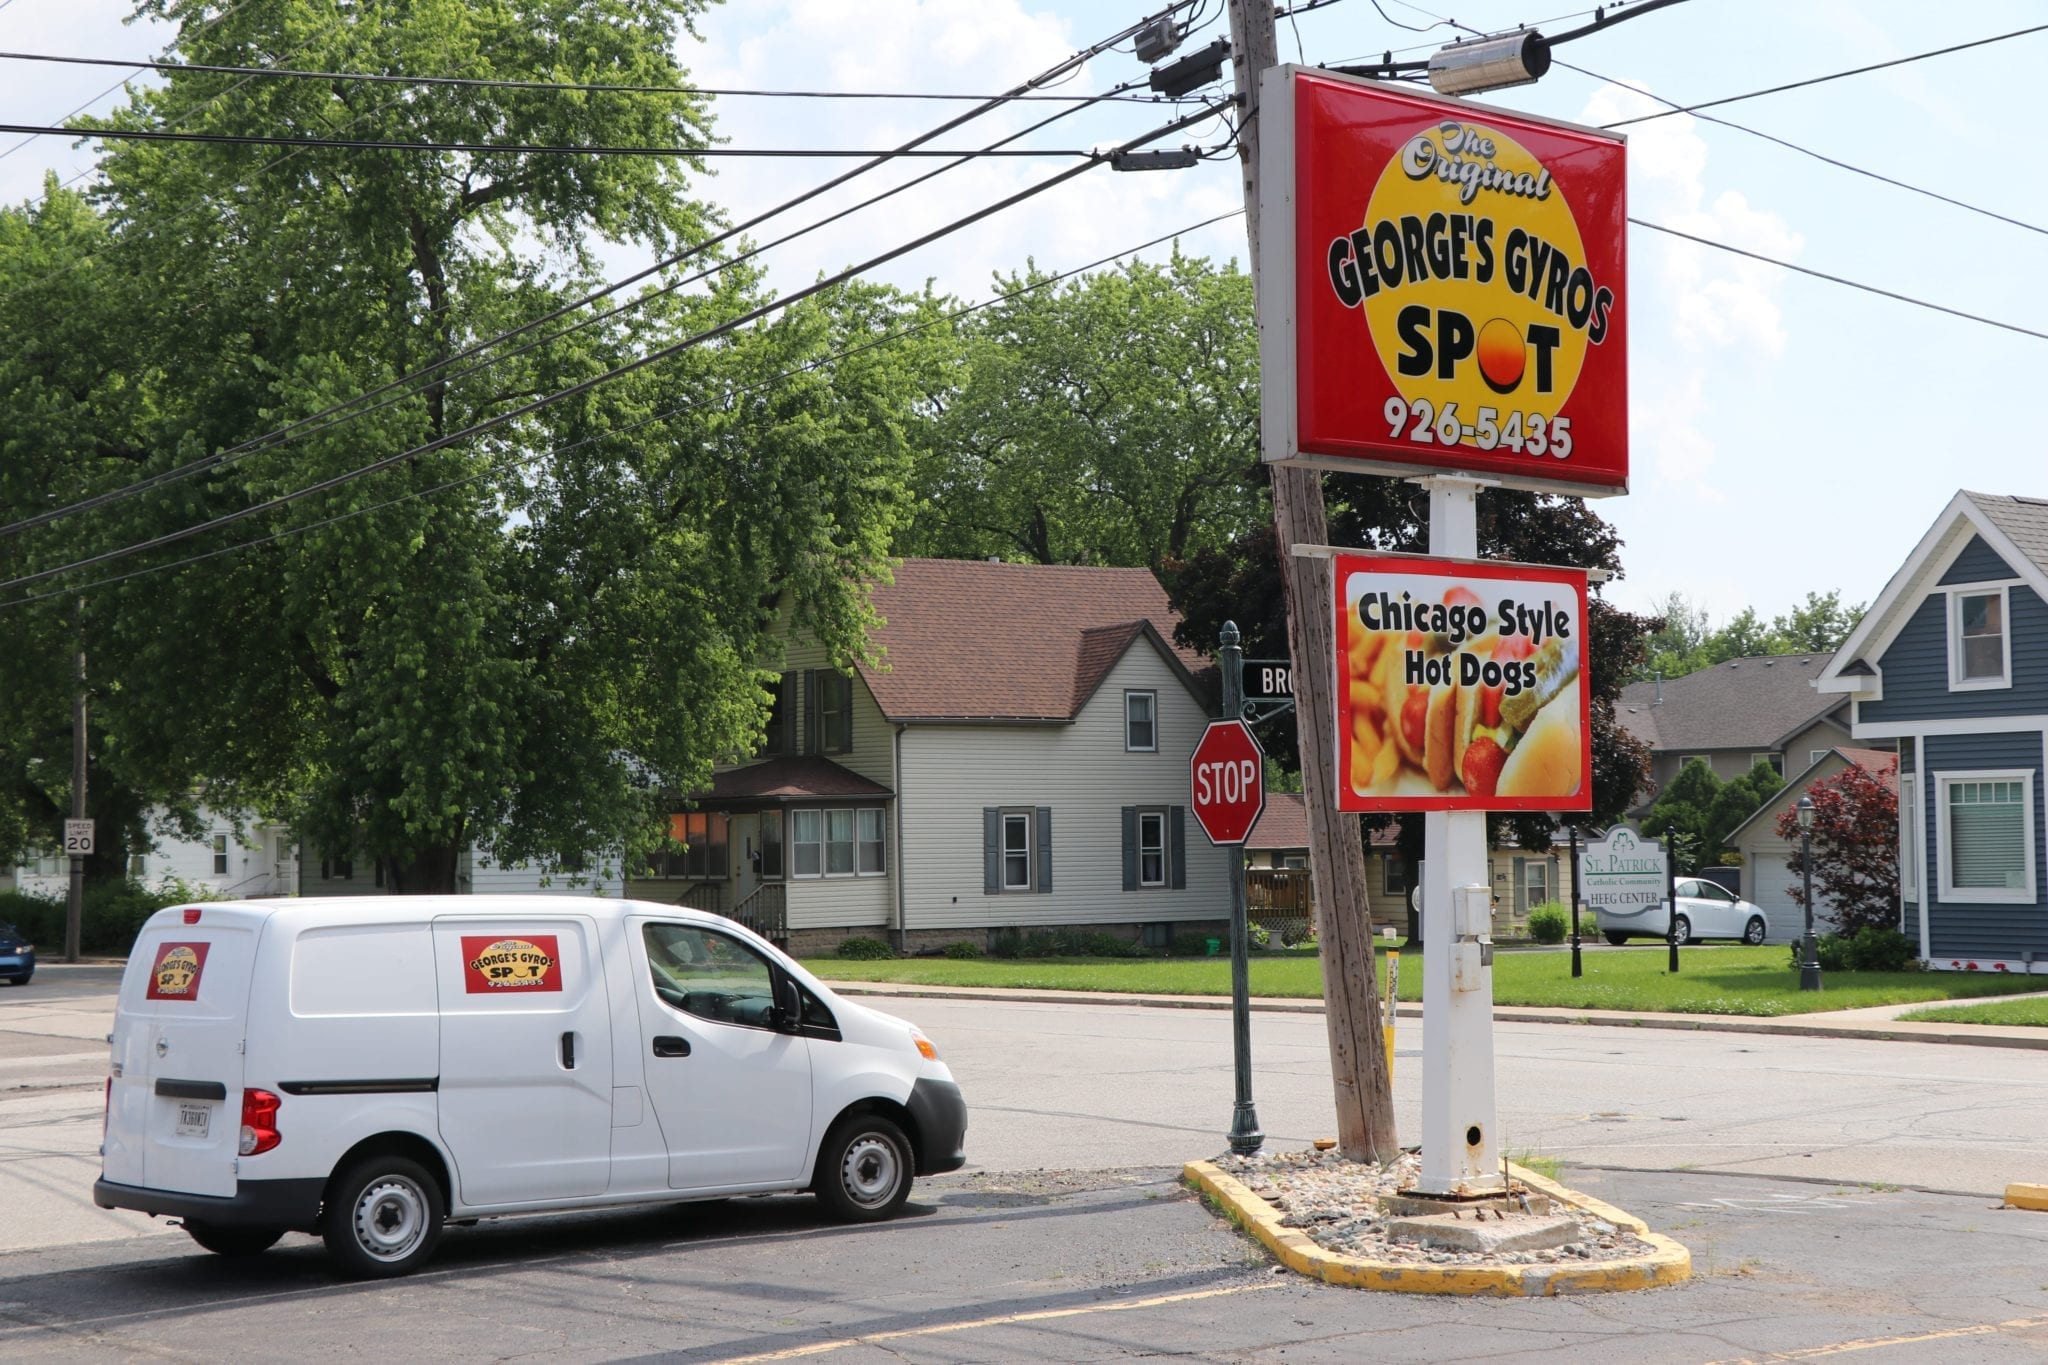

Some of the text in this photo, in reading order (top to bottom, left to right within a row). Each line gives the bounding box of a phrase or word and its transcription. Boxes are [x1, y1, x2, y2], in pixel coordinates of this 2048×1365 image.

[1439, 120, 1496, 159] The
[1401, 136, 1551, 205] Original
[1328, 212, 1615, 344] GEORGE'S GYROS
[1397, 305, 1560, 394] SPOT
[1384, 397, 1573, 459] 926-5435
[1357, 590, 1571, 645] Chicago Style
[1405, 649, 1537, 696] Hot Dogs
[1197, 759, 1255, 806] STOP
[67, 837, 91, 850] 20
[1586, 877, 1662, 888] Catholic Community
[1591, 892, 1658, 905] HEEG CENTER
[470, 953, 555, 971] GEORGE'S GYROS
